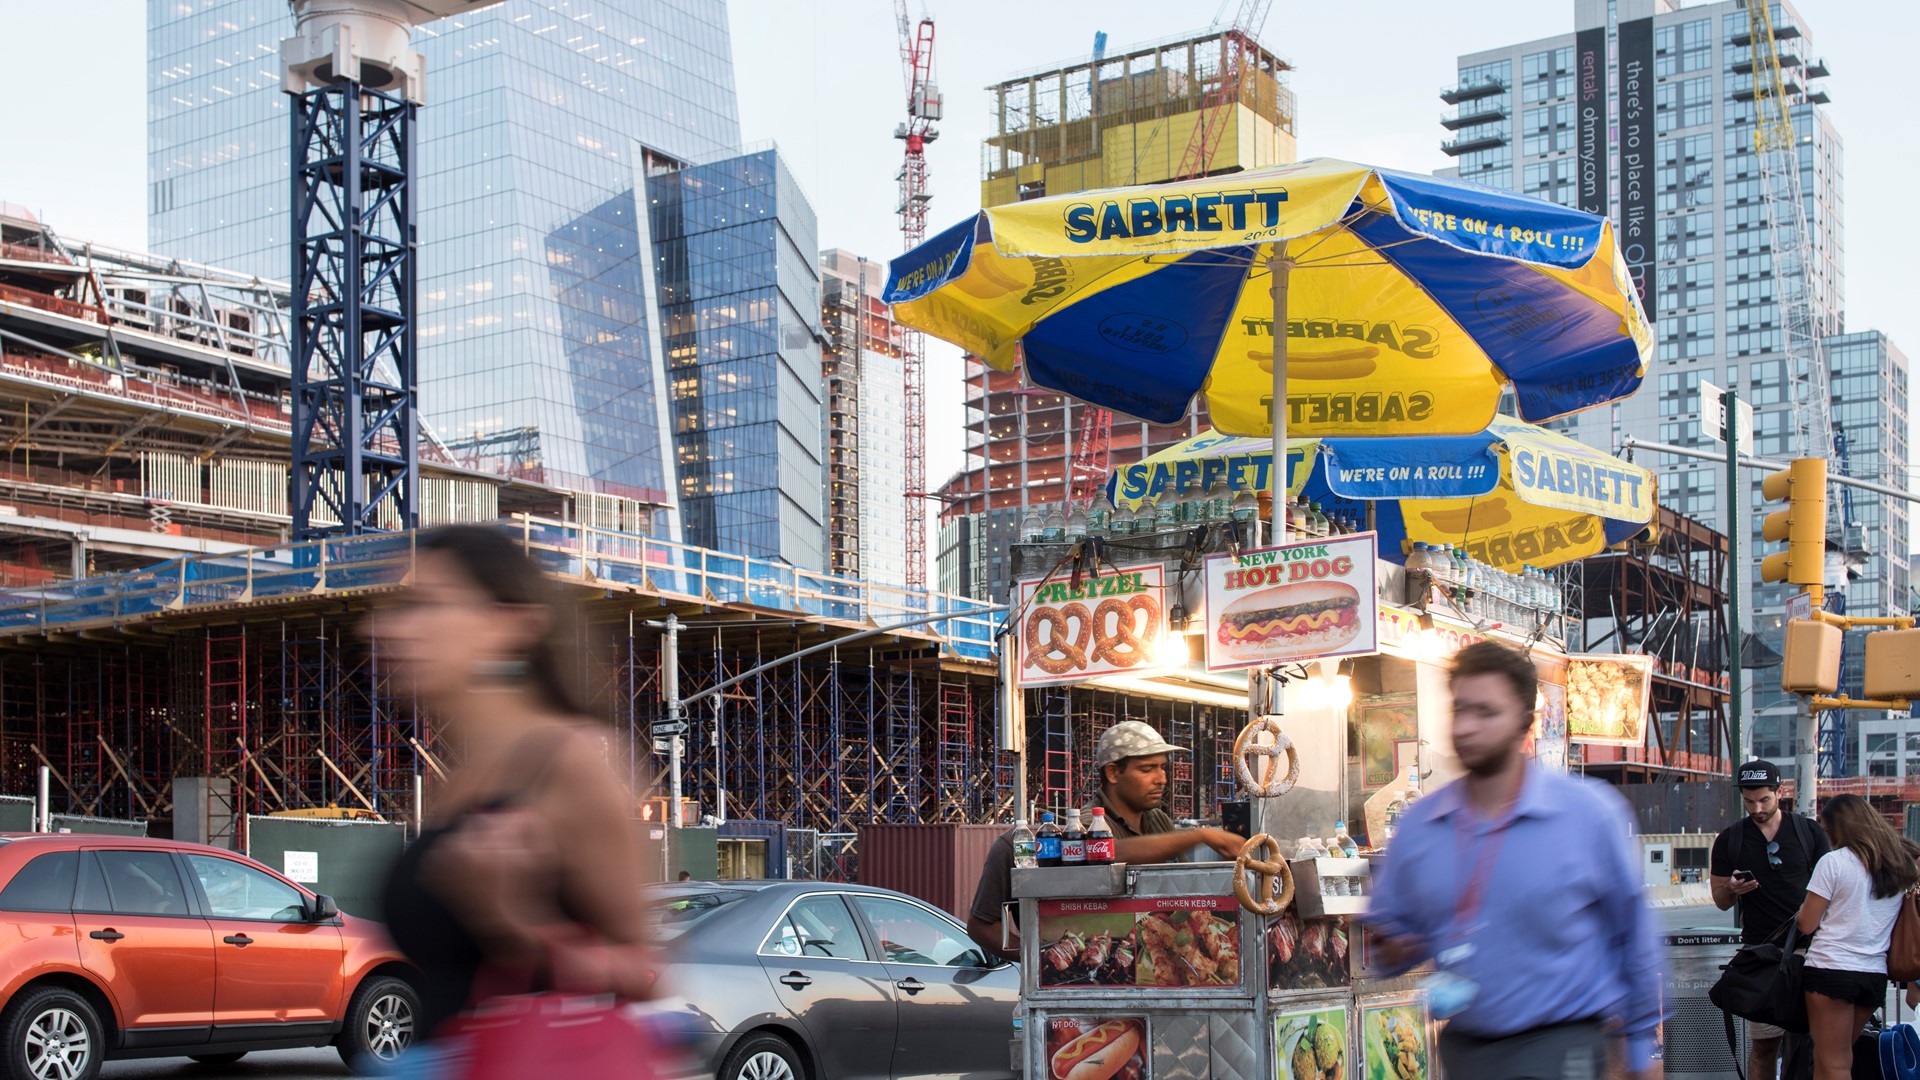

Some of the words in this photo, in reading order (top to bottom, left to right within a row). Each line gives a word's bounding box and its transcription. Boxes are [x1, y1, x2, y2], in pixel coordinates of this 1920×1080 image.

[1583, 50, 1598, 101] rentals
[1626, 60, 1643, 119] there's
[1580, 107, 1598, 197] ohmny.com
[1627, 125, 1640, 147] no
[1625, 154, 1644, 201] place
[1063, 187, 1288, 243] SABRETT
[1627, 205, 1645, 237] like
[1462, 217, 1488, 236] ON
[1493, 223, 1505, 239] A
[1510, 226, 1556, 248] ROLL
[1562, 235, 1585, 252] !!!
[896, 267, 925, 292] WE'RE
[926, 260, 938, 281] ON
[938, 257, 944, 275] A
[1339, 468, 1385, 483] WE'RE
[1389, 467, 1410, 481] ON
[1414, 466, 1424, 480] A
[1428, 466, 1463, 480] ROLL
[1467, 465, 1485, 479] !!!
[1514, 446, 1643, 509] SABRETT
[1239, 551, 1278, 568] NEW
[1281, 545, 1330, 562] YORK
[1034, 572, 1149, 606] PRETZEL
[1224, 563, 1285, 591] HOT
[1288, 556, 1354, 583] DOG
[654, 725, 666, 733] ONE
[672, 723, 685, 731] WAY
[1705, 782, 1711, 790] 2
[1062, 845, 1082, 856] oke
[1060, 903, 1082, 911] SHISH
[1083, 902, 1108, 911] KEBAB
[1156, 899, 1189, 908] CHICKEN
[1191, 899, 1217, 908] KEBAB
[1666, 980, 1675, 989] in
[1678, 980, 1690, 989] its
[1693, 980, 1716, 990] plac
